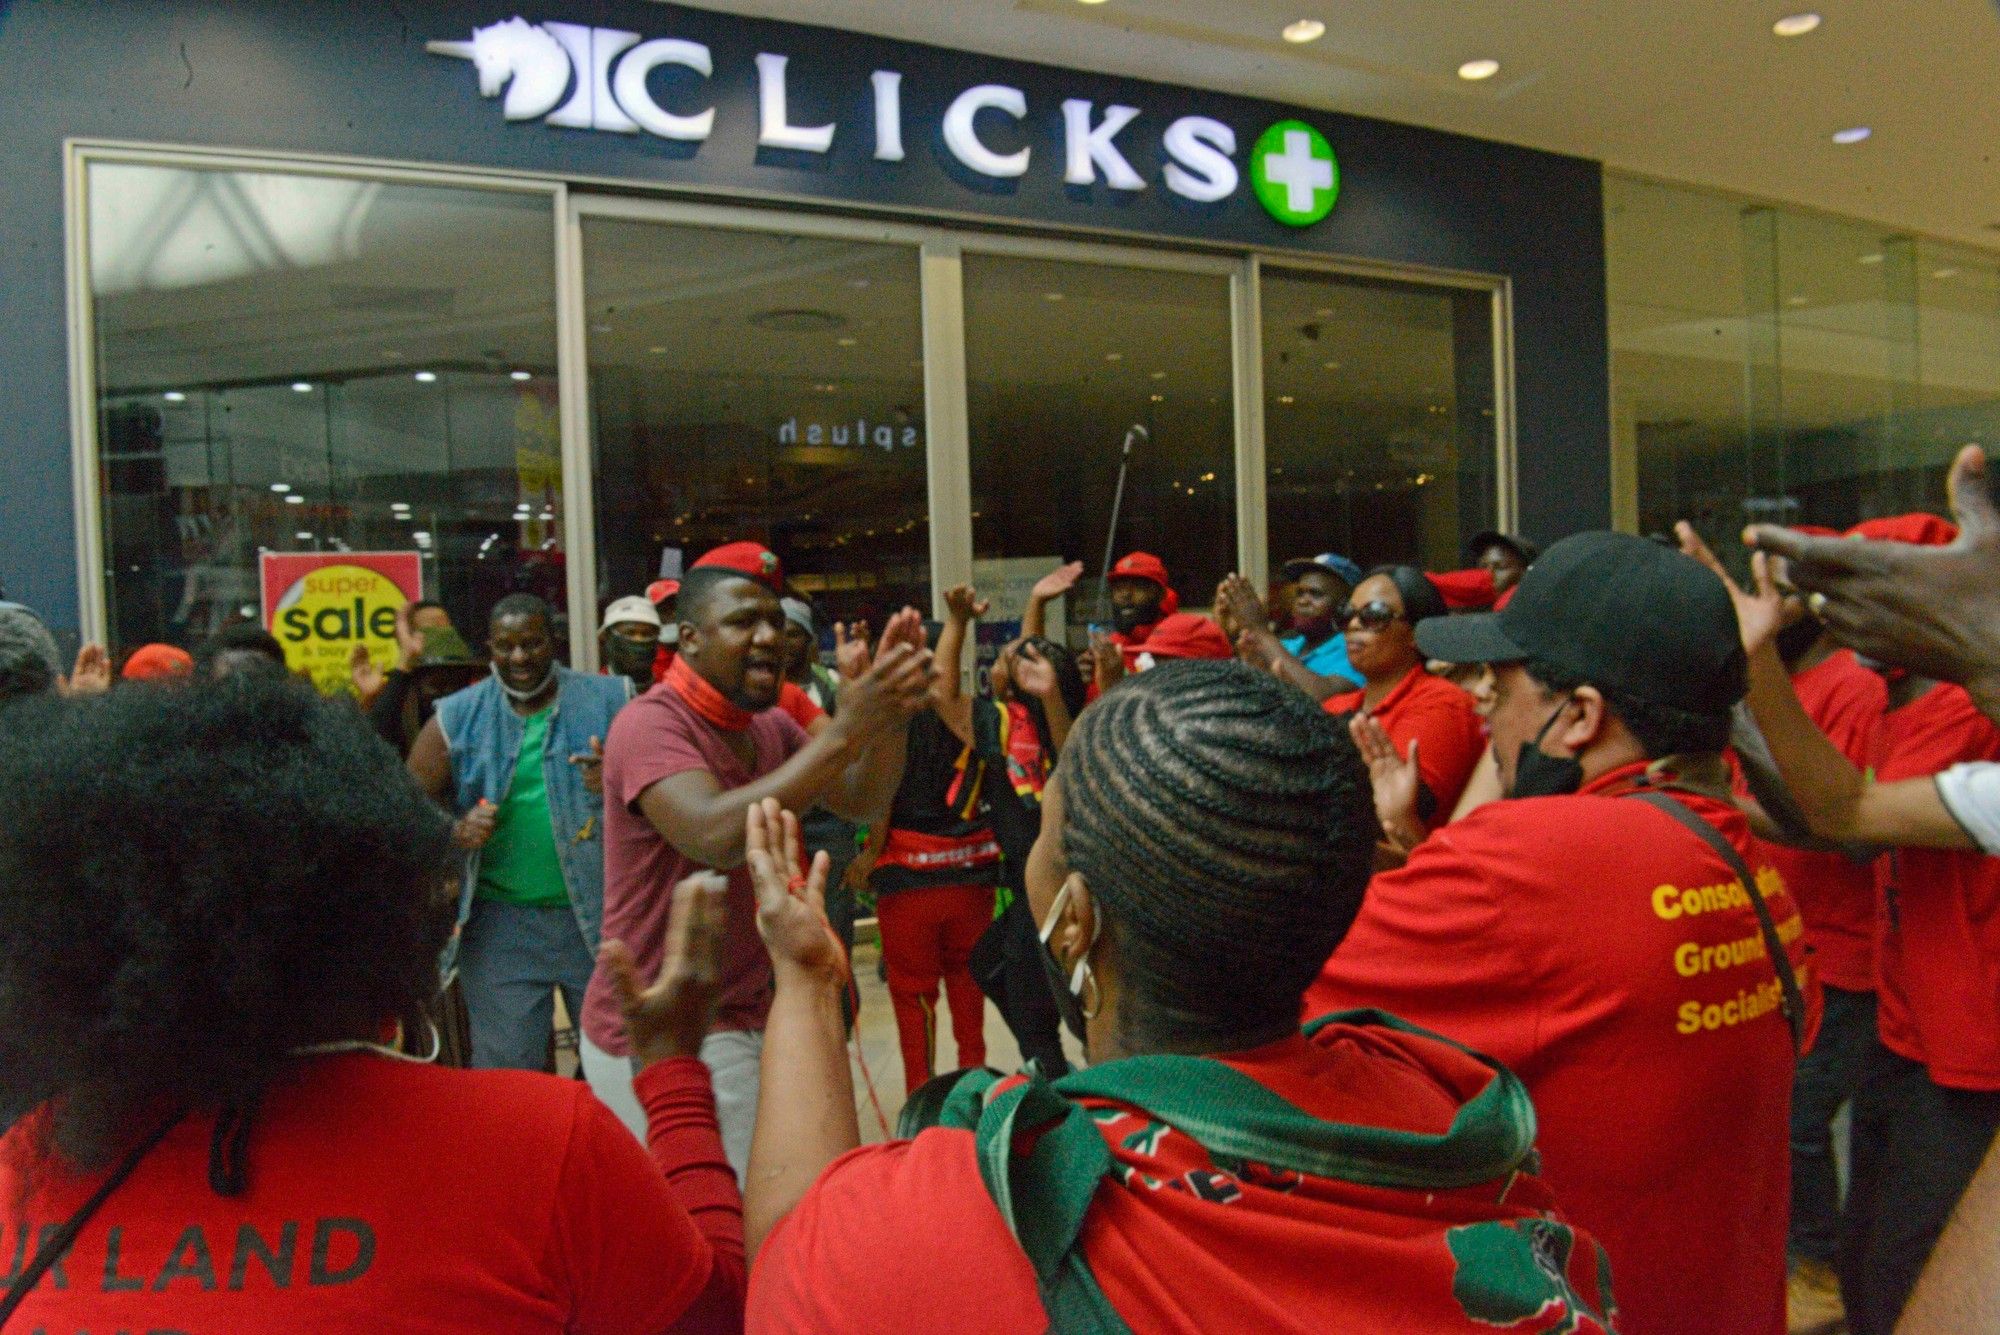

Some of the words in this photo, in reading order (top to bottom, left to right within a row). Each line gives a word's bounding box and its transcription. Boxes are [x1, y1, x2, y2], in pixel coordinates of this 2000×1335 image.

[613, 39, 1238, 203] CLICKS
[305, 577, 377, 597] super
[284, 597, 397, 641] sale
[101, 1216, 376, 1291] LAND
